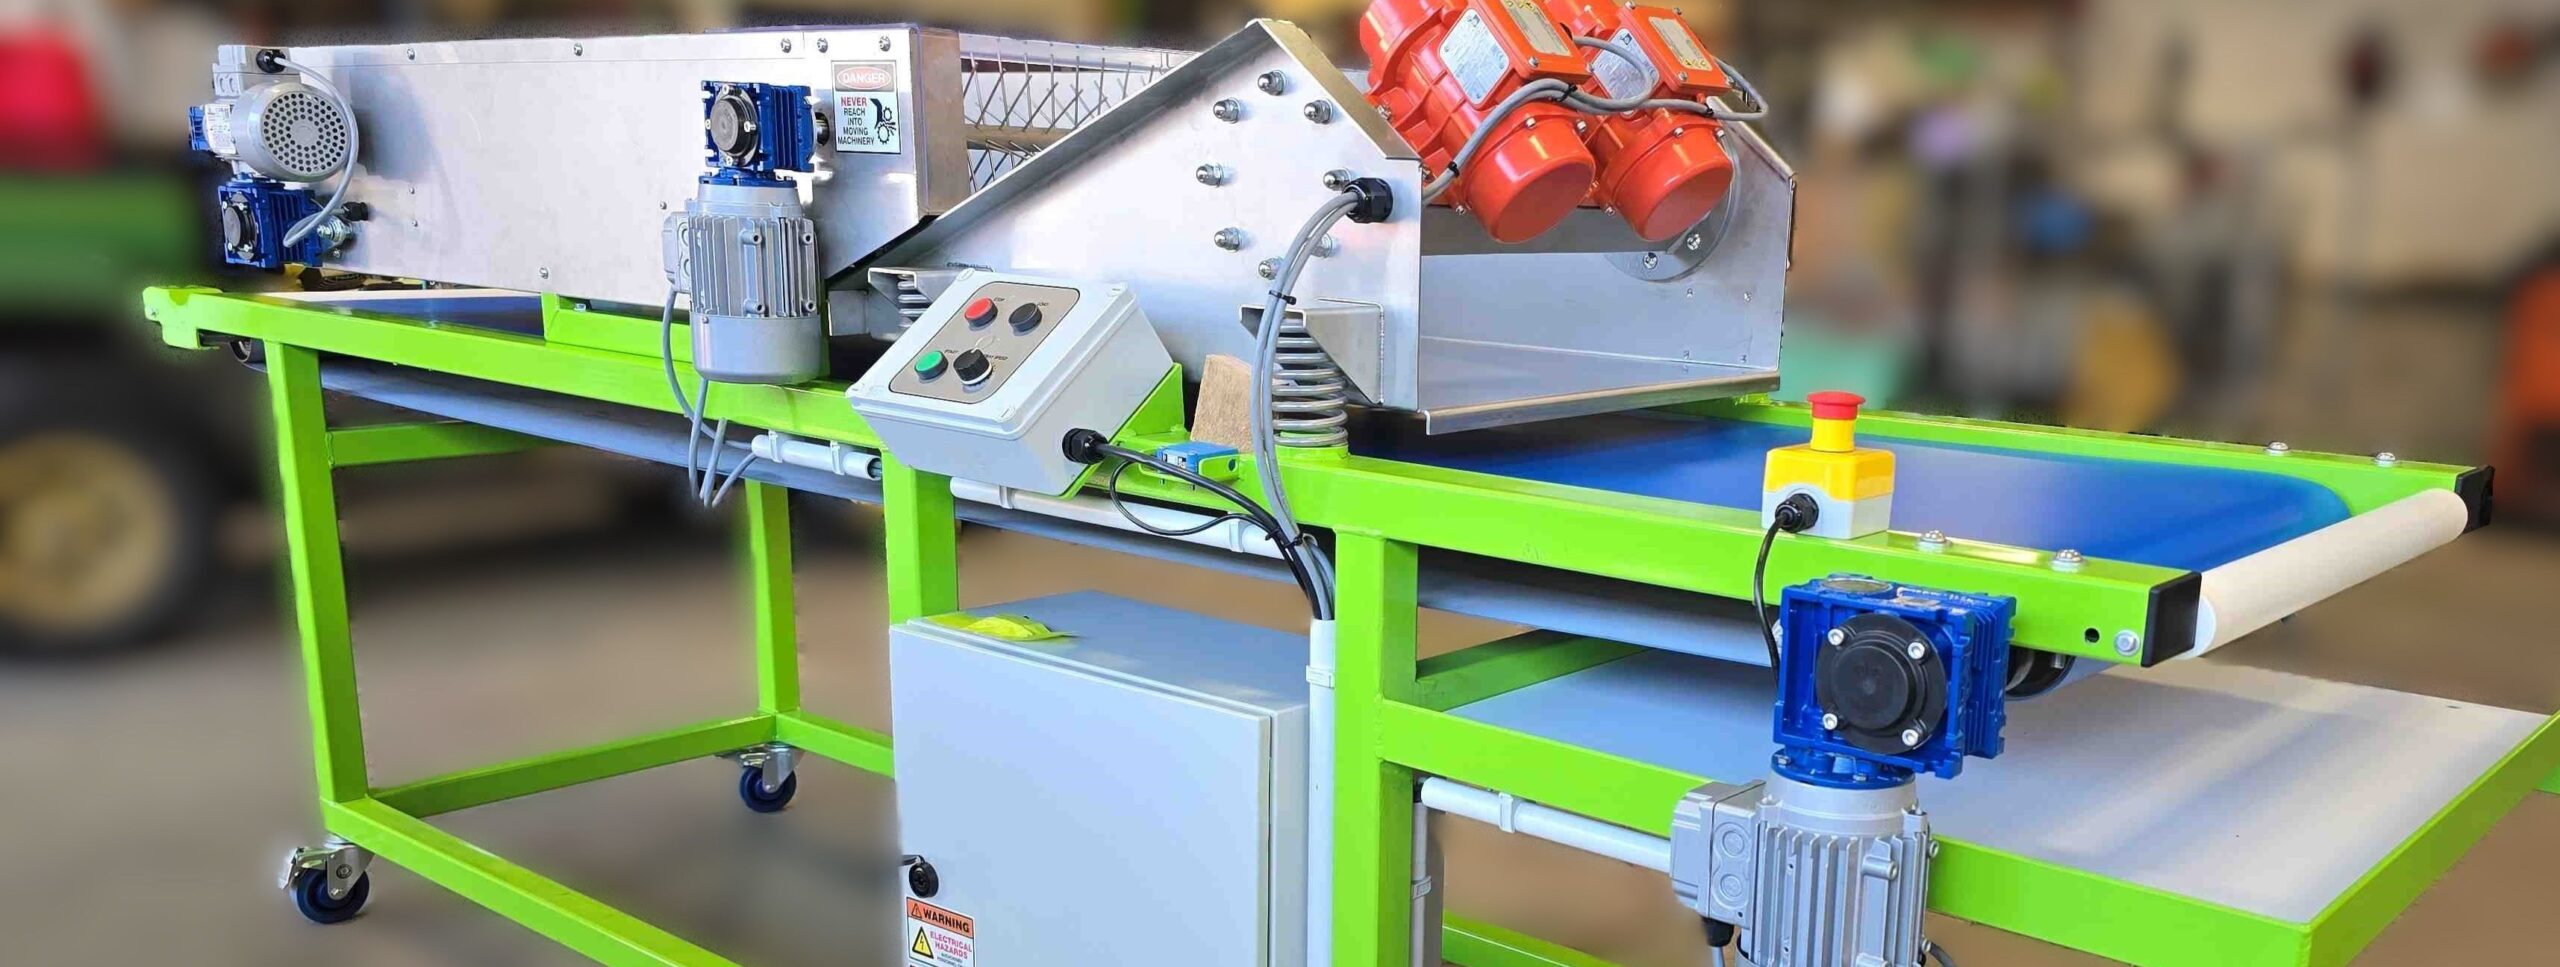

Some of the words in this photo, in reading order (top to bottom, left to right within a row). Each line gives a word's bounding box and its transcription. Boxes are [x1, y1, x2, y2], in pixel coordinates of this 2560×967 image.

[842, 72, 887, 84] DANGER
[841, 97, 867, 107] NEVER
[843, 107, 866, 117] REACH
[847, 117, 863, 126] INTO
[843, 127, 868, 136] MOVING
[837, 136, 875, 146] MACHINERY
[923, 908, 970, 933] WARNING
[930, 931, 972, 953] ELECTRICAL
[935, 942, 968, 960] HAZARDS
